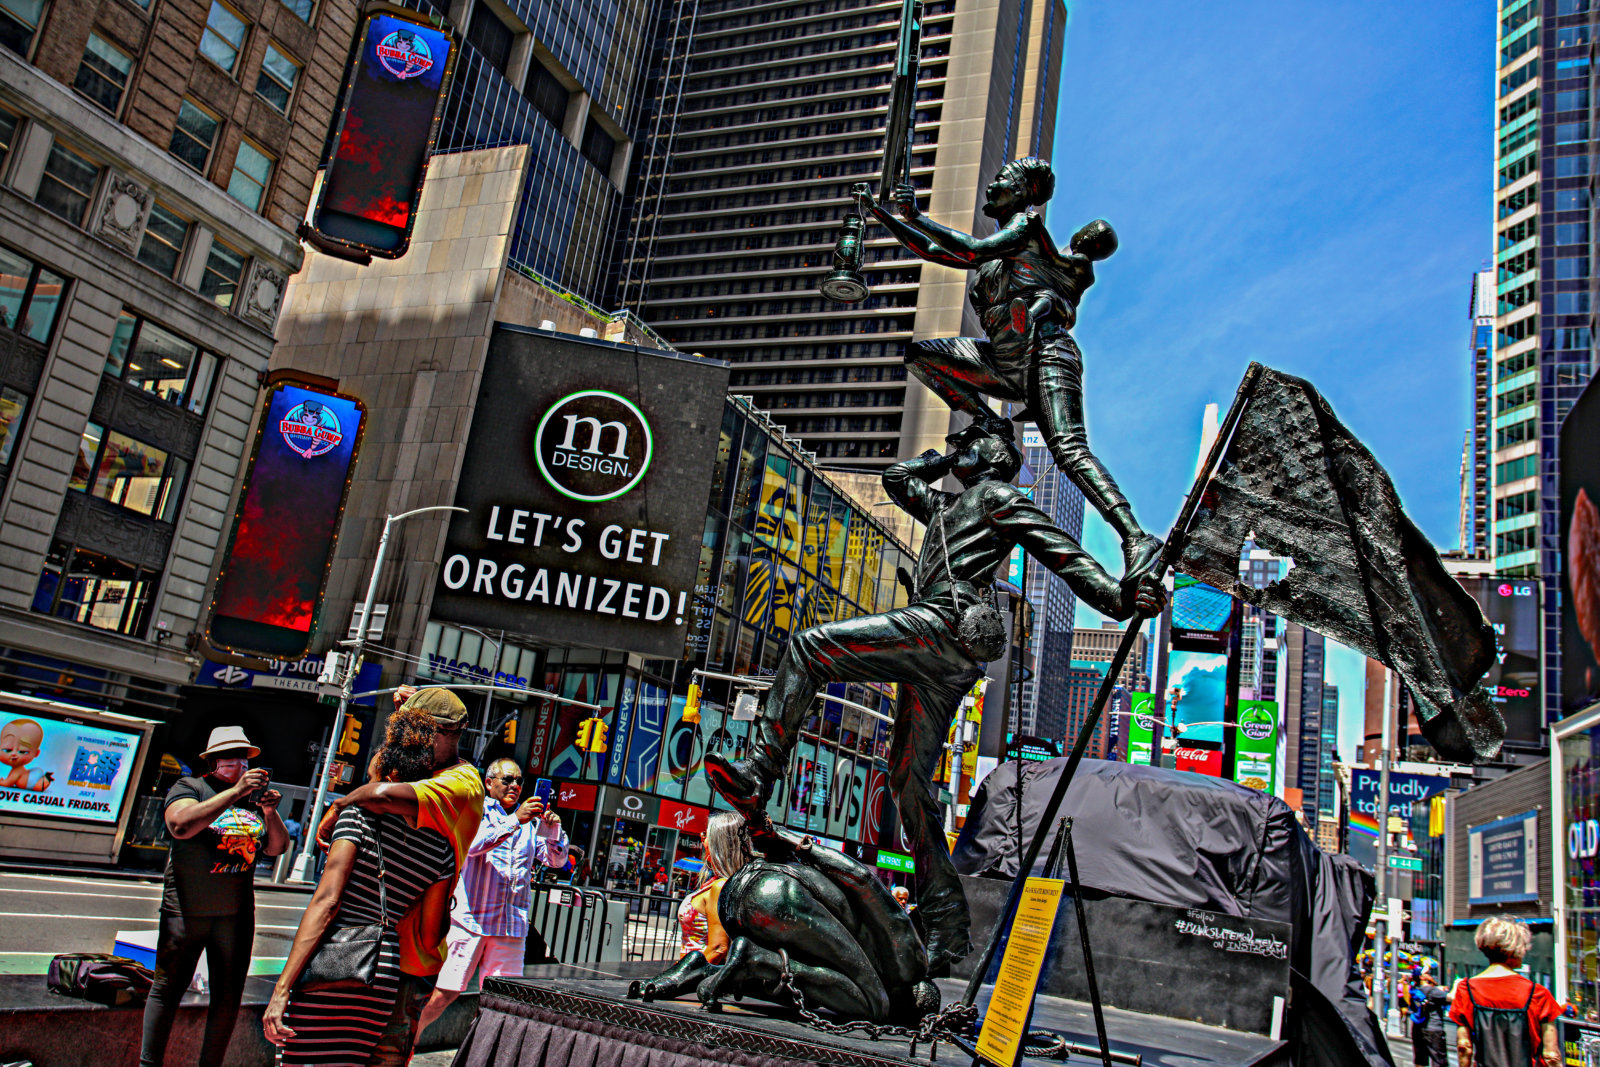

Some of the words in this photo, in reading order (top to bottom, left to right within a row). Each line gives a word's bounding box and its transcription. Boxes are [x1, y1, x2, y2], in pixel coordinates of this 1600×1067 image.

[379, 46, 407, 61] BUBBA
[408, 53, 432, 69] GUMP
[282, 421, 313, 436] BUBBA
[314, 427, 341, 443] GUMP
[555, 413, 630, 461] m
[486, 505, 586, 553] LET'S
[599, 524, 670, 566] GET
[443, 554, 687, 626] ORGANIZED!
[1513, 586, 1531, 596] LG
[274, 678, 320, 691] THEATER
[618, 687, 632, 732] NEWS
[1243, 721, 1272, 730] Green
[1246, 728, 1271, 738] Giant
[533, 728, 545, 755] CBS
[613, 734, 624, 763] CBS
[1358, 775, 1430, 800] Prudly
[23, 793, 66, 808] CASUAL
[68, 798, 111, 813] FRIDAYS.
[616, 808, 647, 821] OAKLEY
[1567, 818, 1600, 859] OLD
[210, 862, 229, 874] Let
[231, 863, 239, 873] it
